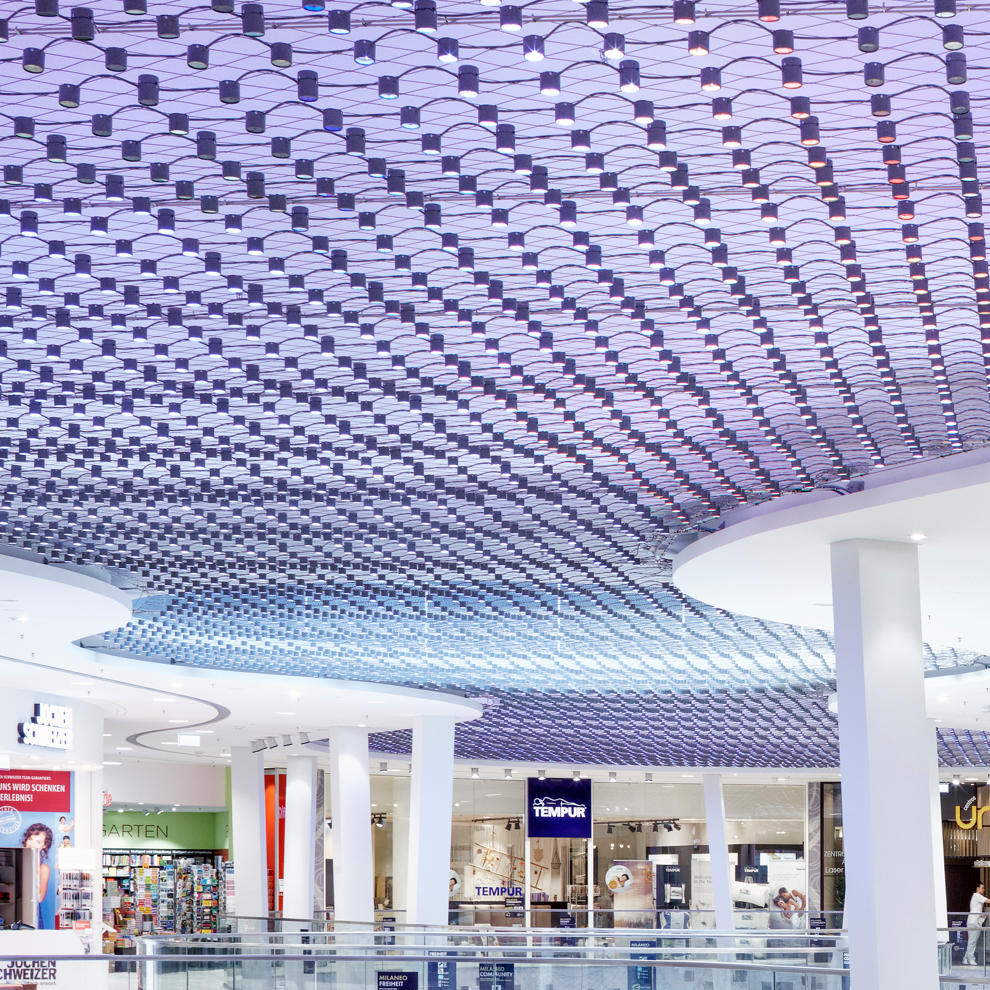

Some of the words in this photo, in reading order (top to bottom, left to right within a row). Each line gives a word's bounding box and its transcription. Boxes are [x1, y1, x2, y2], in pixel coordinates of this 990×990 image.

[12, 783, 31, 792] WIRD
[31, 784, 66, 793] SCHENKEN
[0, 793, 33, 802] ERLEBNIS!
[533, 806, 586, 818] TEMPUR
[475, 886, 523, 897] TEMPUR
